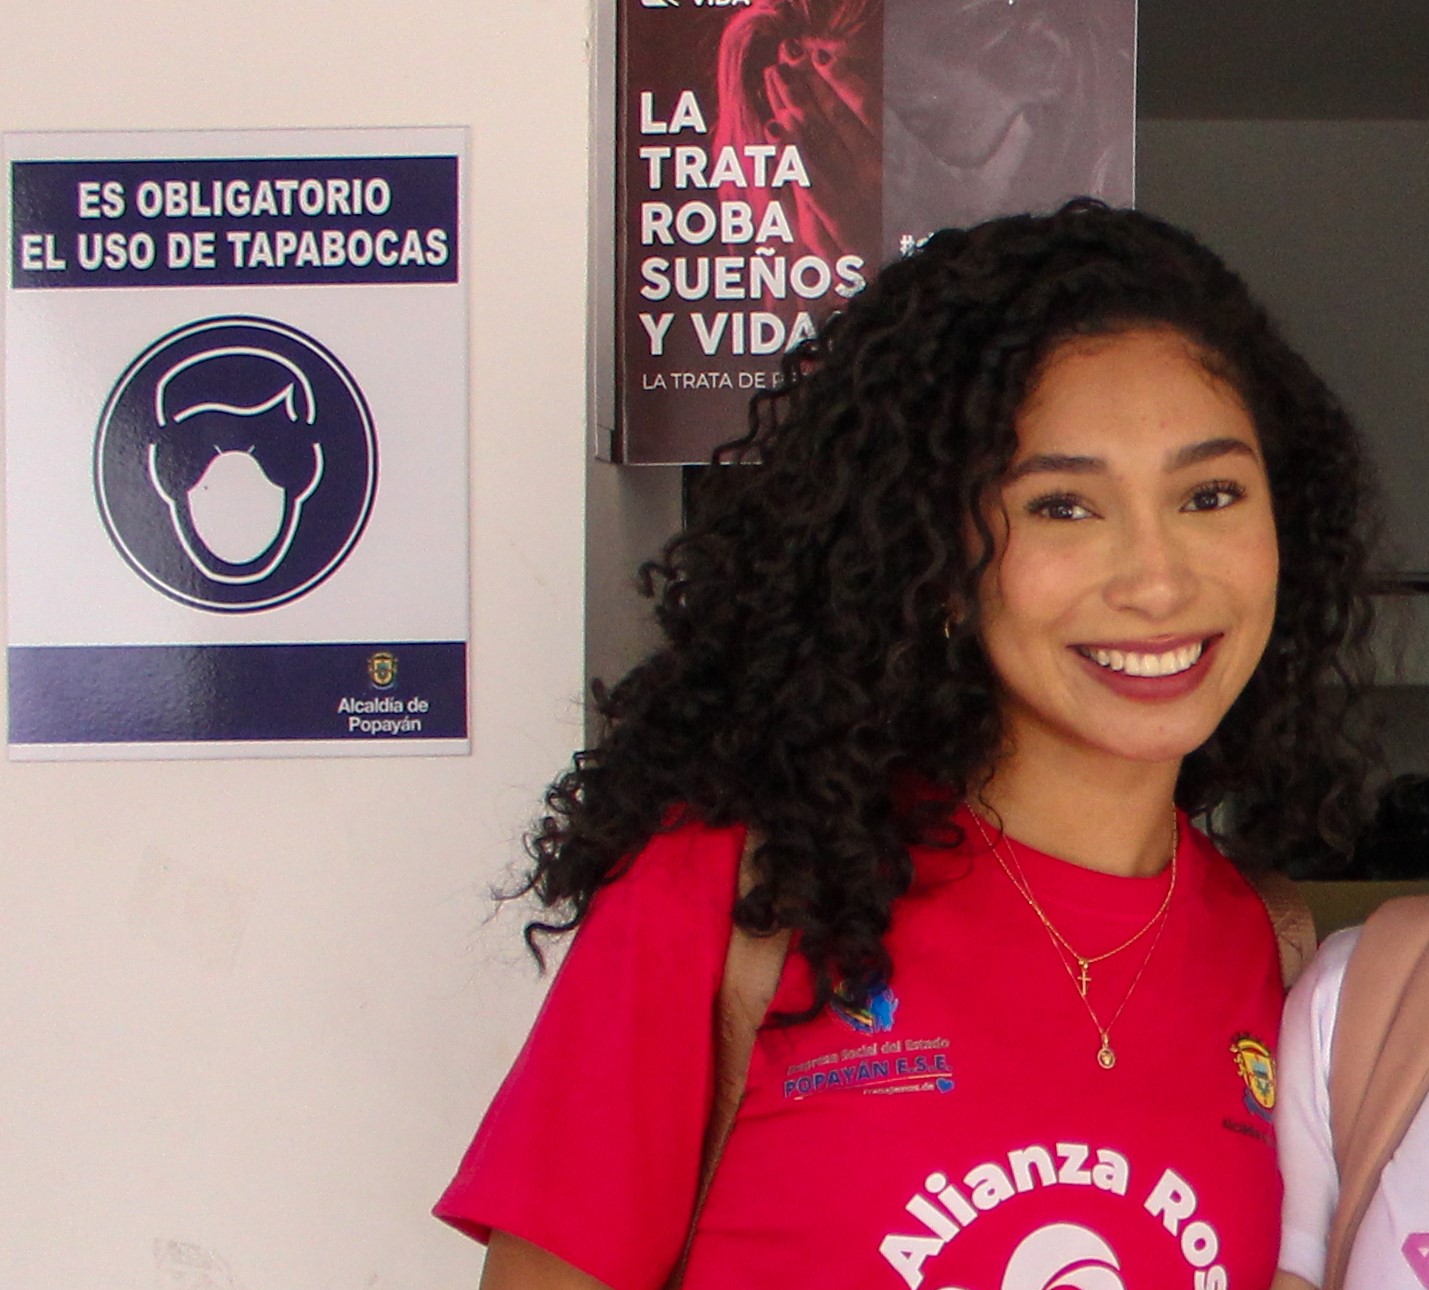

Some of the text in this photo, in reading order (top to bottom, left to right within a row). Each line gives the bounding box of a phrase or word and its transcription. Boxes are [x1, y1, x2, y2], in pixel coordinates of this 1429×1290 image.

[640, 90, 707, 135] LA
[640, 144, 811, 189] TRATA
[78, 178, 392, 218] ES OBLIGATORIO
[641, 201, 793, 245] ROBA
[21, 229, 449, 271] EL USO DE TAPABOCAS
[641, 248, 866, 299] SUEÑOS
[640, 312, 843, 355] Y VIDA
[643, 373, 667, 390] LA
[671, 373, 733, 389] TRATA
[739, 372, 766, 388] DE
[337, 697, 429, 714] Alcaldía de
[348, 716, 422, 735] Popayán
[784, 1060, 890, 1098] POPAYÁN
